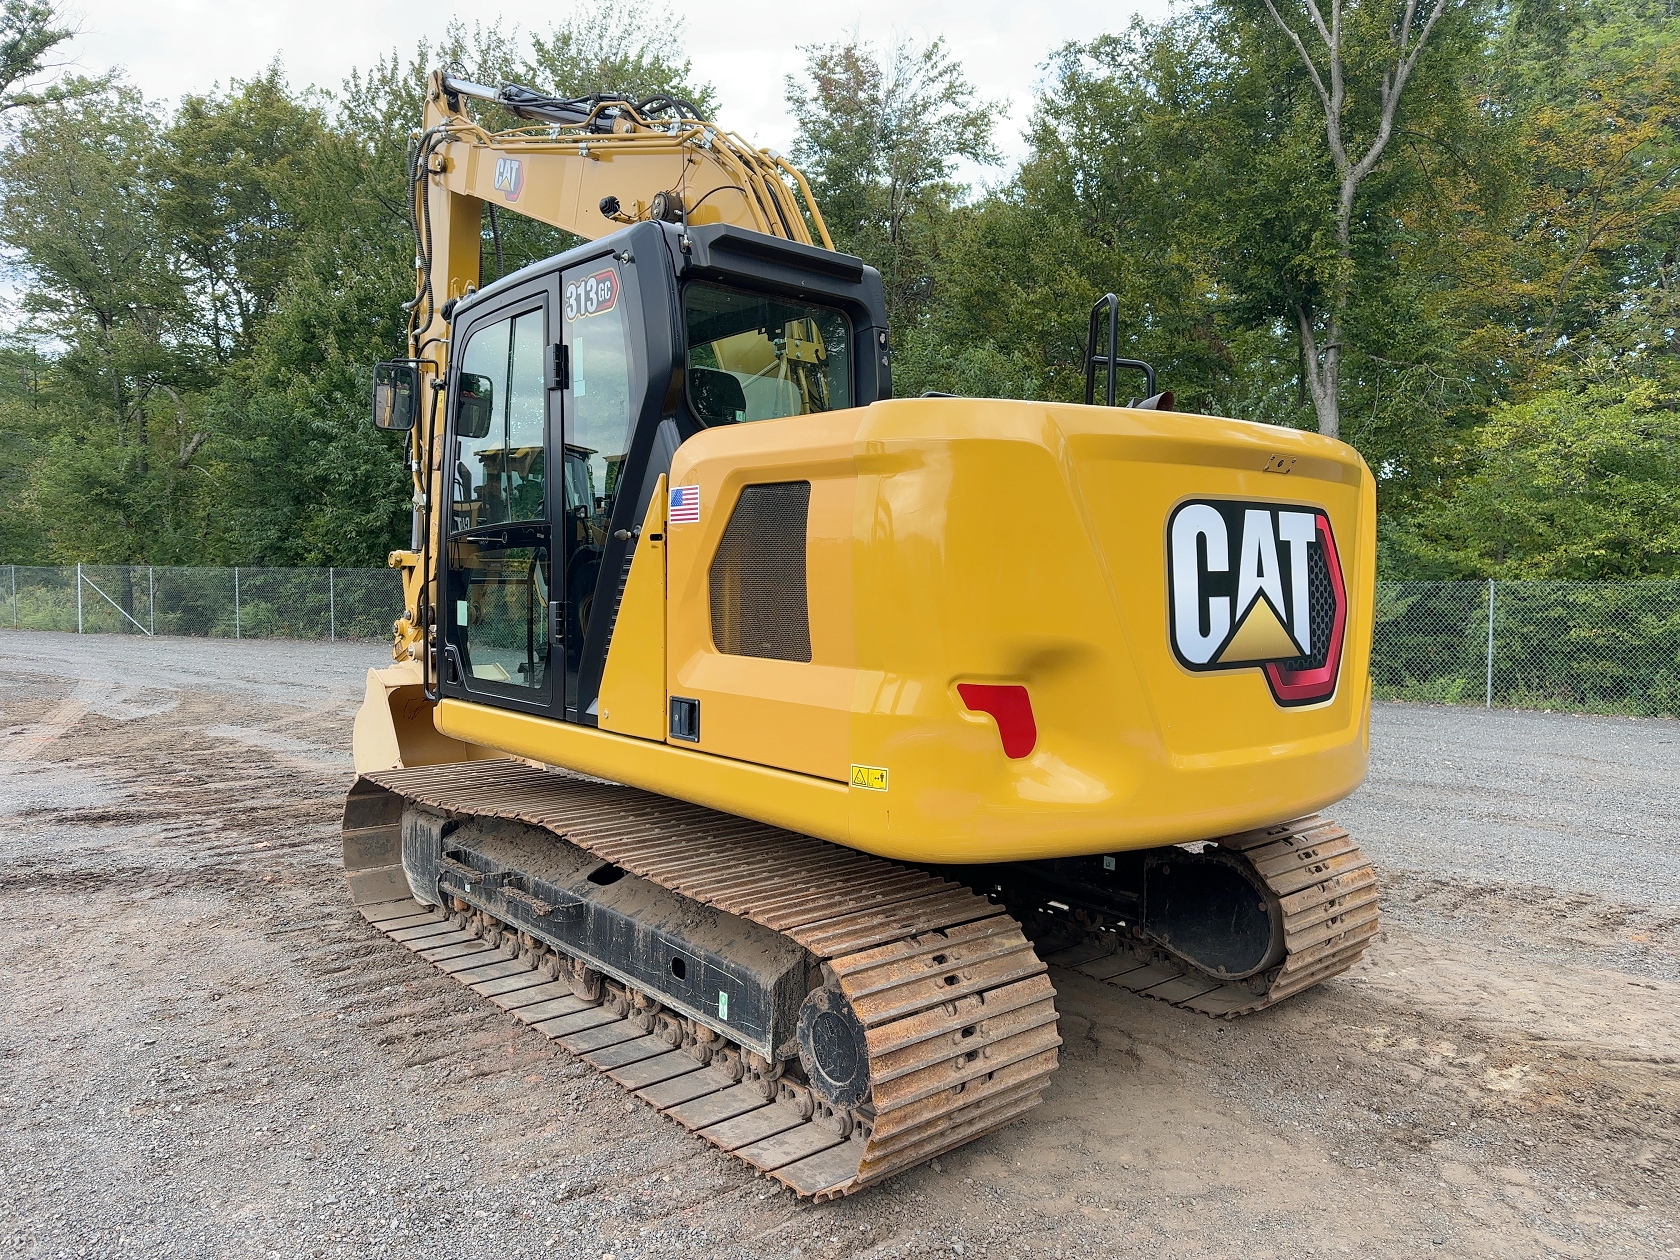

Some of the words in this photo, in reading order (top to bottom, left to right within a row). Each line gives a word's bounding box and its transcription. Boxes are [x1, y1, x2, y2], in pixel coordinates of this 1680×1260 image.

[494, 158, 519, 192] CAT
[566, 277, 597, 319] 313
[598, 280, 611, 302] GC
[1171, 503, 1317, 665] CAT
